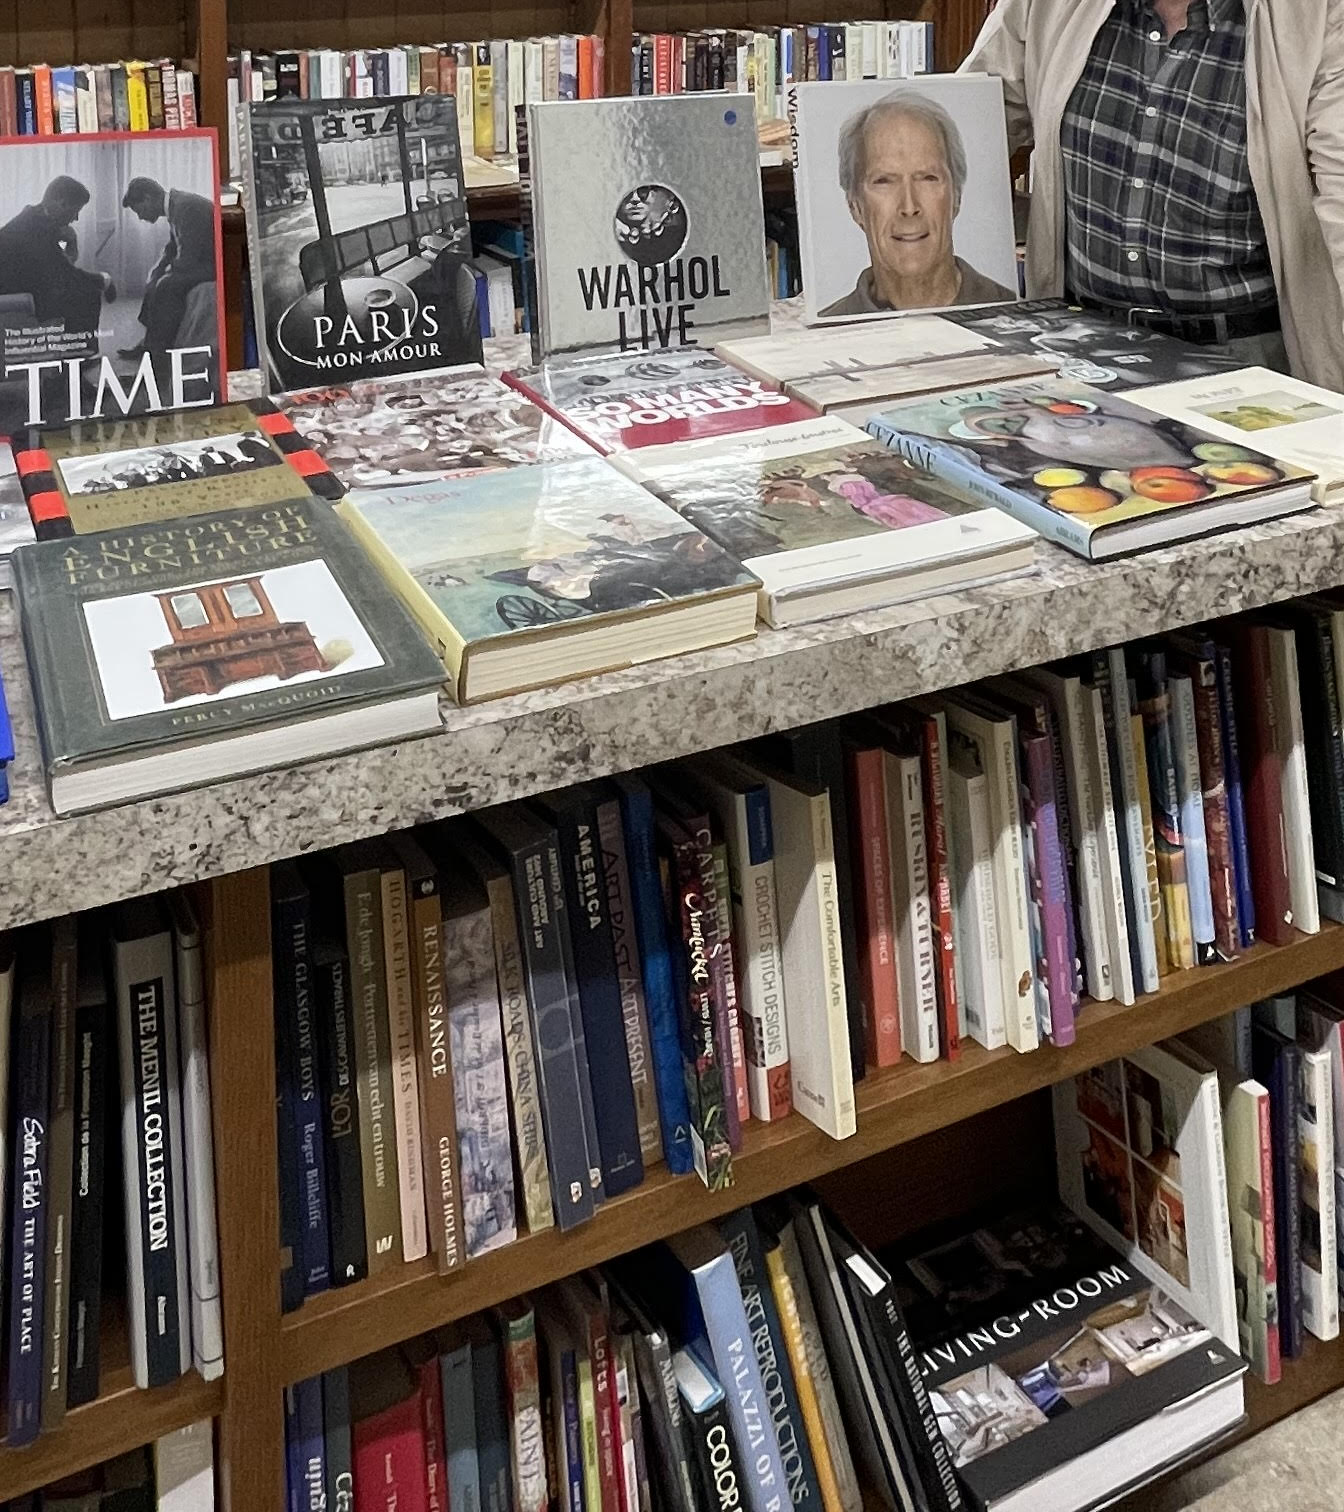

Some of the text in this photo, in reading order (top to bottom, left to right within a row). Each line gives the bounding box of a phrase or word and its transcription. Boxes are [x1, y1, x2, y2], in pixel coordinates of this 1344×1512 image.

[162, 65, 177, 105] THOMAS
[787, 88, 800, 170] Wisdom
[577, 254, 731, 311] WARHOL
[5, 323, 66, 337] The Illustrated
[5, 331, 93, 346] History of the World's
[48, 340, 88, 352] Magazine
[313, 304, 440, 349] PARIS
[315, 341, 442, 370] MON AMOUR
[618, 303, 698, 353] LIVE
[5, 345, 215, 426] TIME
[561, 380, 765, 420] SO MANY
[581, 391, 791, 433] WORLDS
[62, 504, 301, 559] A HISTORY OF
[62, 513, 313, 572] ENGLISH
[66, 530, 319, 586] FURNITURE
[170, 706, 233, 727] PERCY
[1227, 719, 1238, 756] STYLE
[575, 824, 602, 931] AMERICA
[871, 835, 889, 965] SPACES OF EXPERIENCE
[292, 922, 307, 954] THE
[601, 848, 632, 973] ART PAST
[820, 870, 843, 1008] The Comfortable Arts
[909, 810, 936, 1014] RUSKIN TURNER
[387, 879, 413, 1093] HOGARTH TIMES
[753, 875, 783, 1057] CROCHET STITCH DESIGNS
[295, 961, 312, 1050] GLASGOW
[422, 924, 447, 1080] RENAISSANCE
[508, 988, 526, 1041] ROADS
[618, 977, 649, 1087] ART PRESENT
[300, 1053, 314, 1102] BOYS
[513, 1046, 533, 1109] CHINA
[137, 986, 169, 1252] THE MENIL COLLECTION
[303, 1122, 317, 1166] Roger
[374, 1144, 387, 1189] trouw
[437, 1136, 458, 1268] GEORGE HOLMES
[20, 1117, 44, 1354] Sabra Field THE ART OF PLACE
[730, 1231, 756, 1286] FINE
[742, 1284, 762, 1321] ART
[920, 1263, 1132, 1377] IVING-ROOM
[727, 1337, 777, 1488] PALAZZI OF
[752, 1319, 810, 1505] REPRODUCTIONS
[896, 1330, 963, 1512] THE NATIONAL GEM COLLECTION
